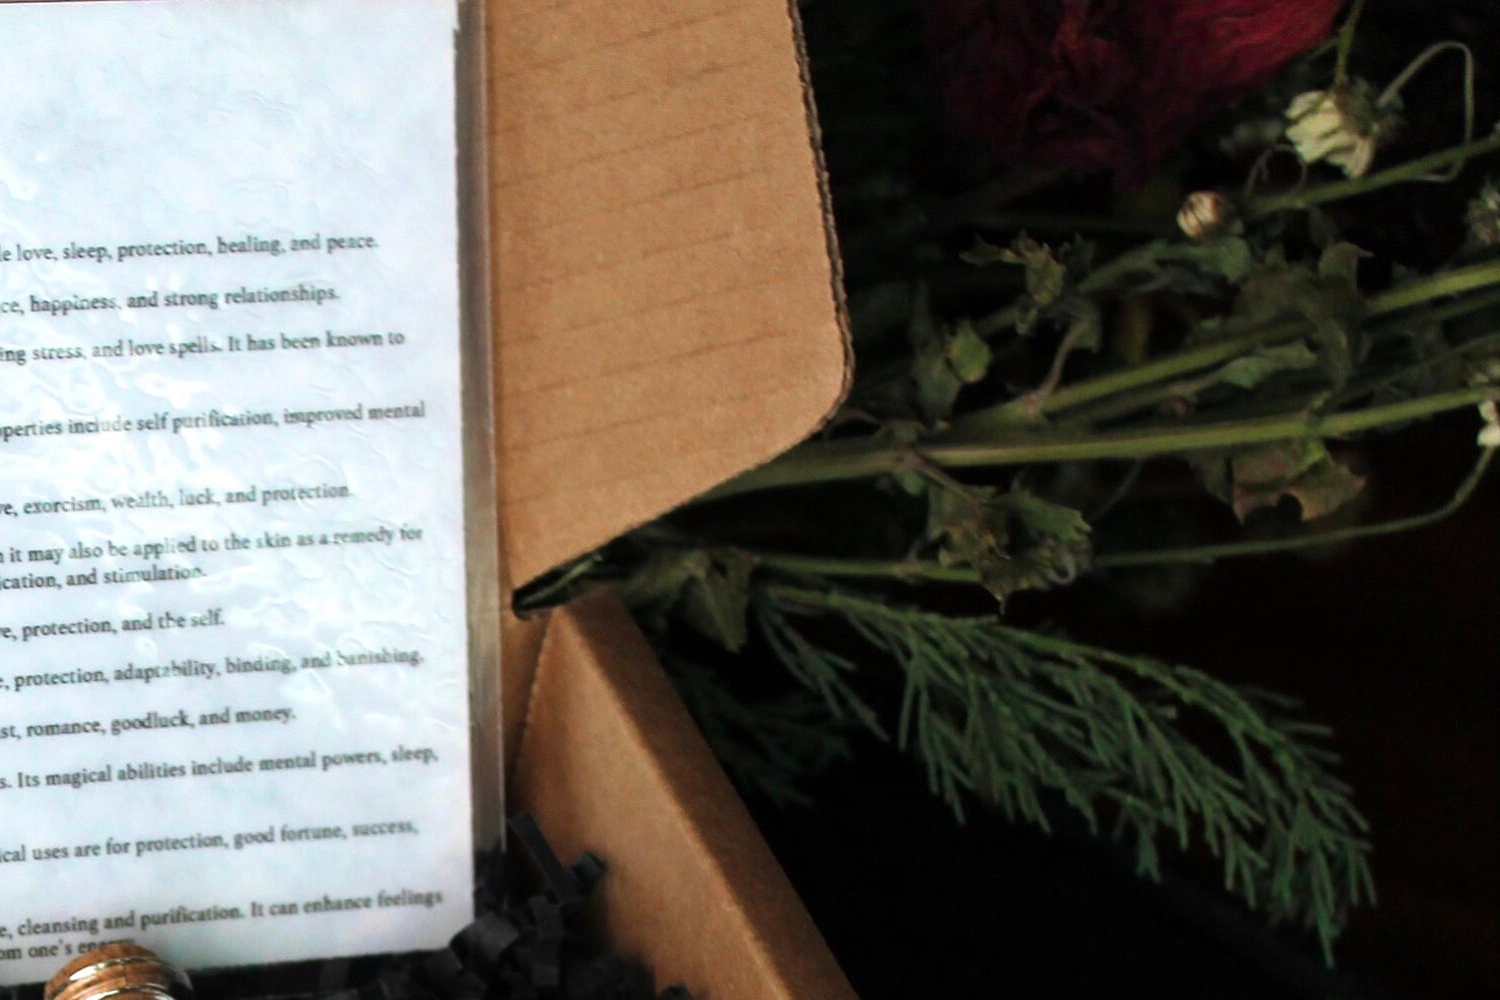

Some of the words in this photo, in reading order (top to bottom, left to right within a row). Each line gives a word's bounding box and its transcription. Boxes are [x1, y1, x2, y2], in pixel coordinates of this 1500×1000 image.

[15, 242, 59, 265] love,
[61, 240, 114, 265] sleep,
[116, 238, 214, 264] protection,
[215, 233, 288, 259] healing,
[288, 231, 323, 252] and
[325, 235, 380, 257] peace.
[65, 566, 99, 588] and
[20, 617, 119, 646] protection,
[120, 612, 157, 634] and
[154, 611, 188, 632] the
[188, 608, 226, 630] self.
[16, 769, 42, 790] Its
[44, 763, 114, 792] magical
[116, 761, 188, 783] abilities
[190, 754, 255, 778] include
[257, 749, 318, 773] mental
[320, 751, 389, 775] powers,
[389, 743, 440, 768] sleep,
[27, 940, 73, 959] one's
